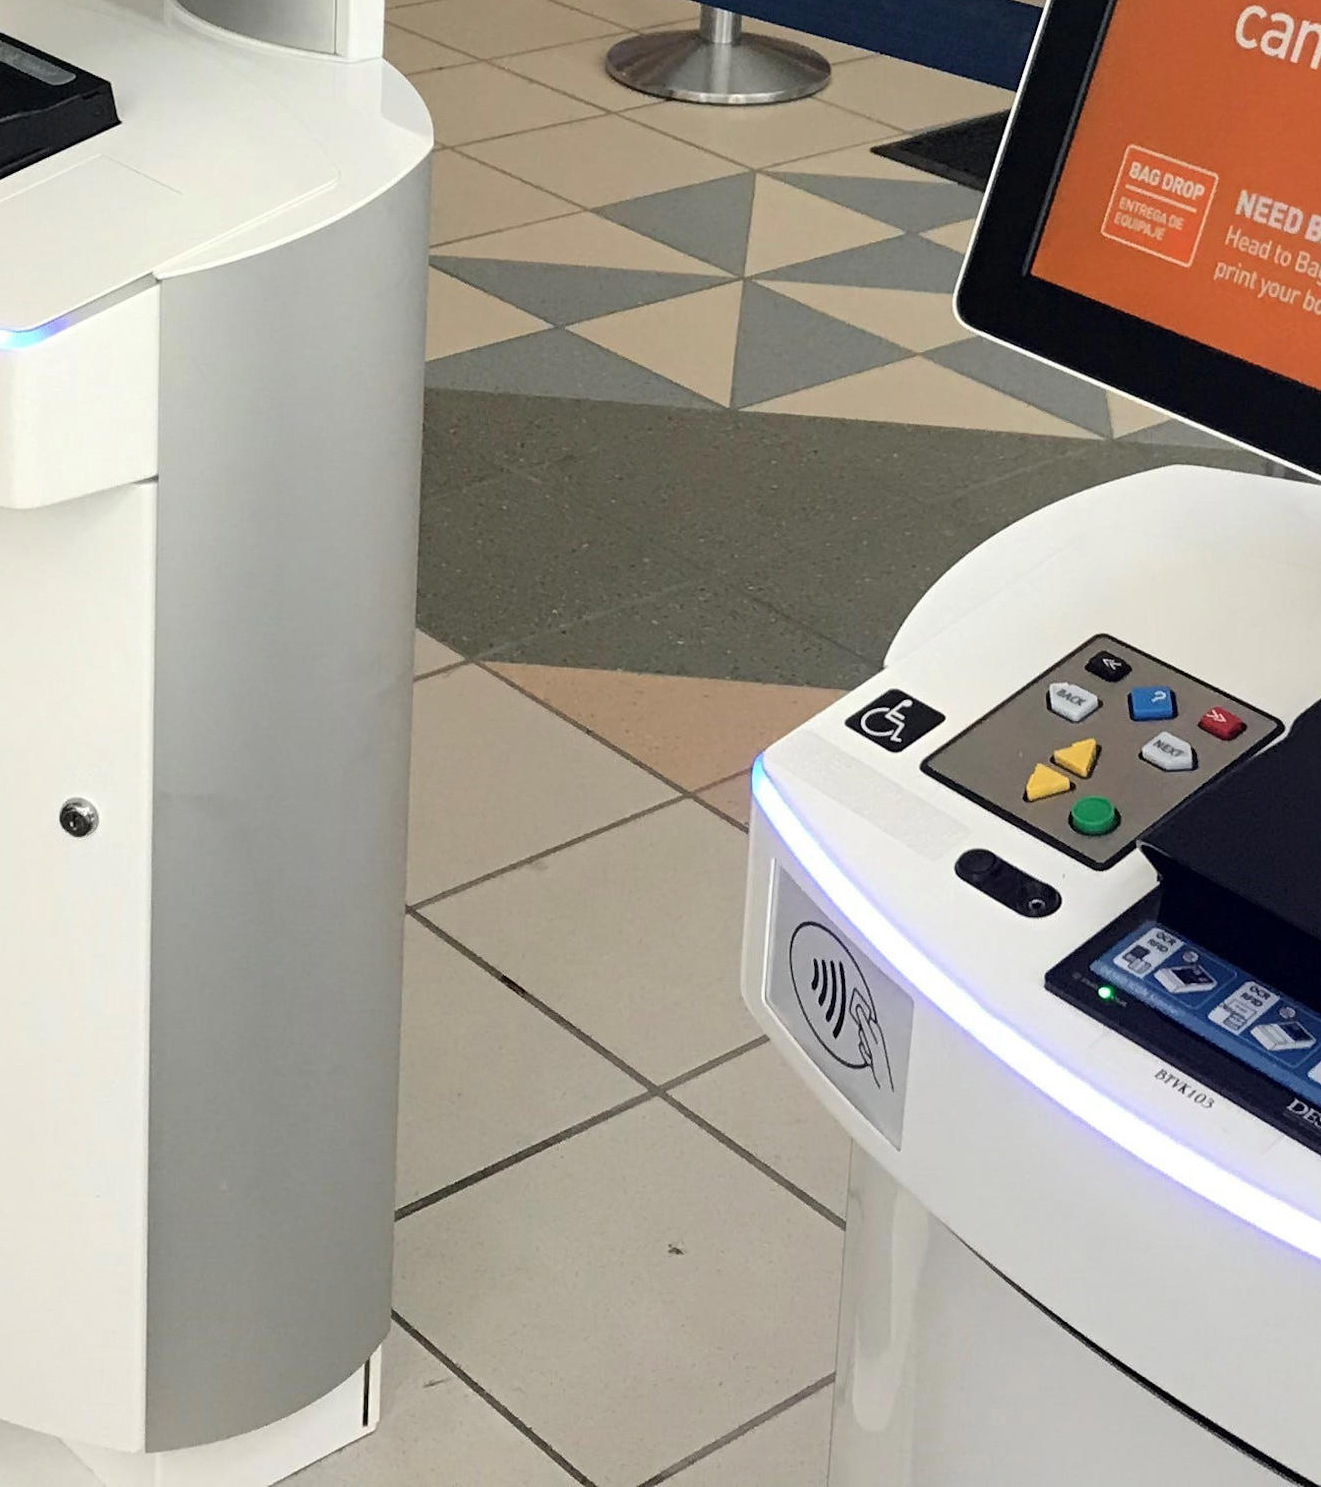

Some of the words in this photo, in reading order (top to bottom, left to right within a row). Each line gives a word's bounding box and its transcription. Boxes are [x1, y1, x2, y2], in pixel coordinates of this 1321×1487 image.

[1129, 161, 1161, 186] BAG
[1161, 173, 1206, 200] DROP
[1114, 211, 1166, 241] EQUIPAJE
[1119, 196, 1168, 226] ENTREGA
[1168, 214, 1185, 231] DE
[1235, 189, 1304, 236] NEED
[1224, 225, 1272, 261] Head
[1274, 243, 1292, 267] to
[1213, 260, 1259, 290] print
[1256, 276, 1302, 306] your
[1055, 688, 1086, 707] BACK
[1152, 739, 1186, 758] NEXT
[1154, 1068, 1216, 1110] BTVK103
